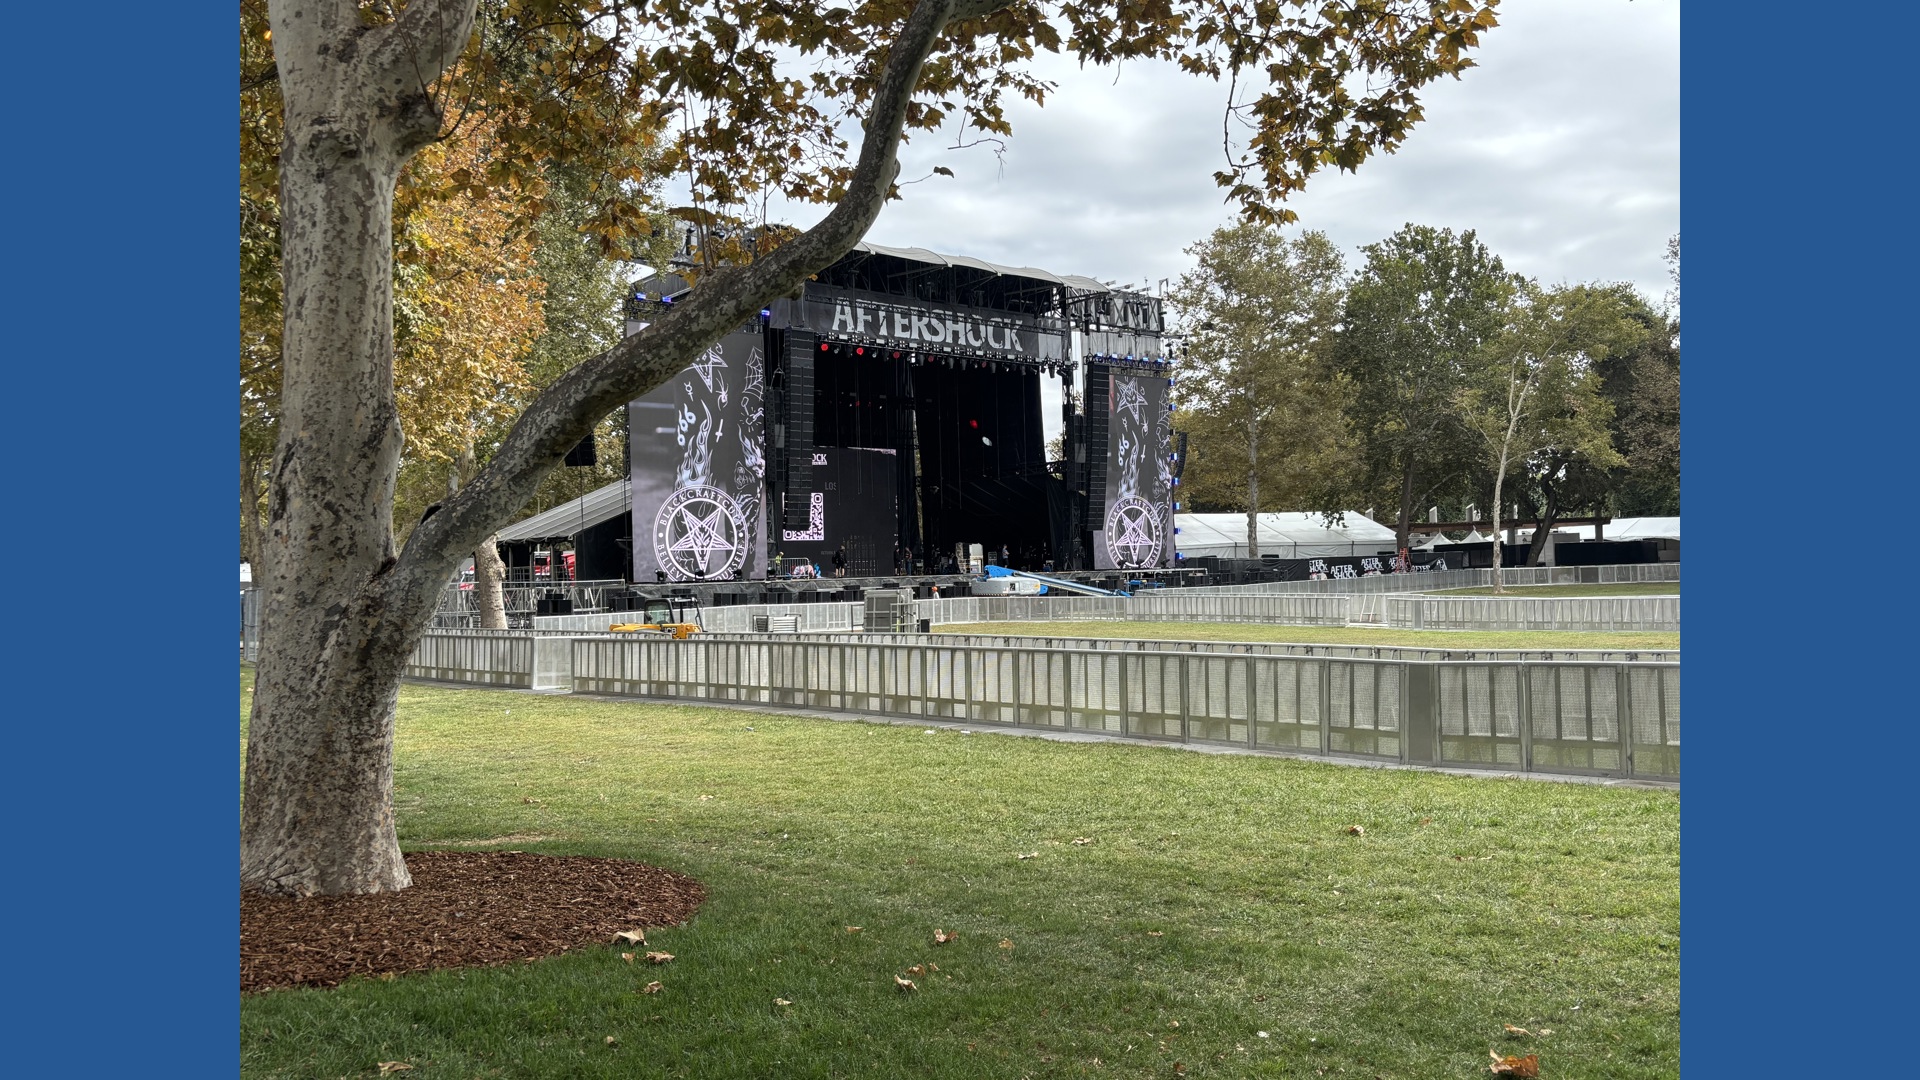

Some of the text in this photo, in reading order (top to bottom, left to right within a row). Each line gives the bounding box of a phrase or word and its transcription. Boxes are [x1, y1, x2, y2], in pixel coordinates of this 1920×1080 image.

[831, 297, 1023, 352] AFTERSHOCK
[708, 539, 745, 581] OURSELF
[1361, 558, 1379, 566] AFTER
[1330, 565, 1353, 574] AFTER
[1334, 570, 1358, 579] SHOCK
